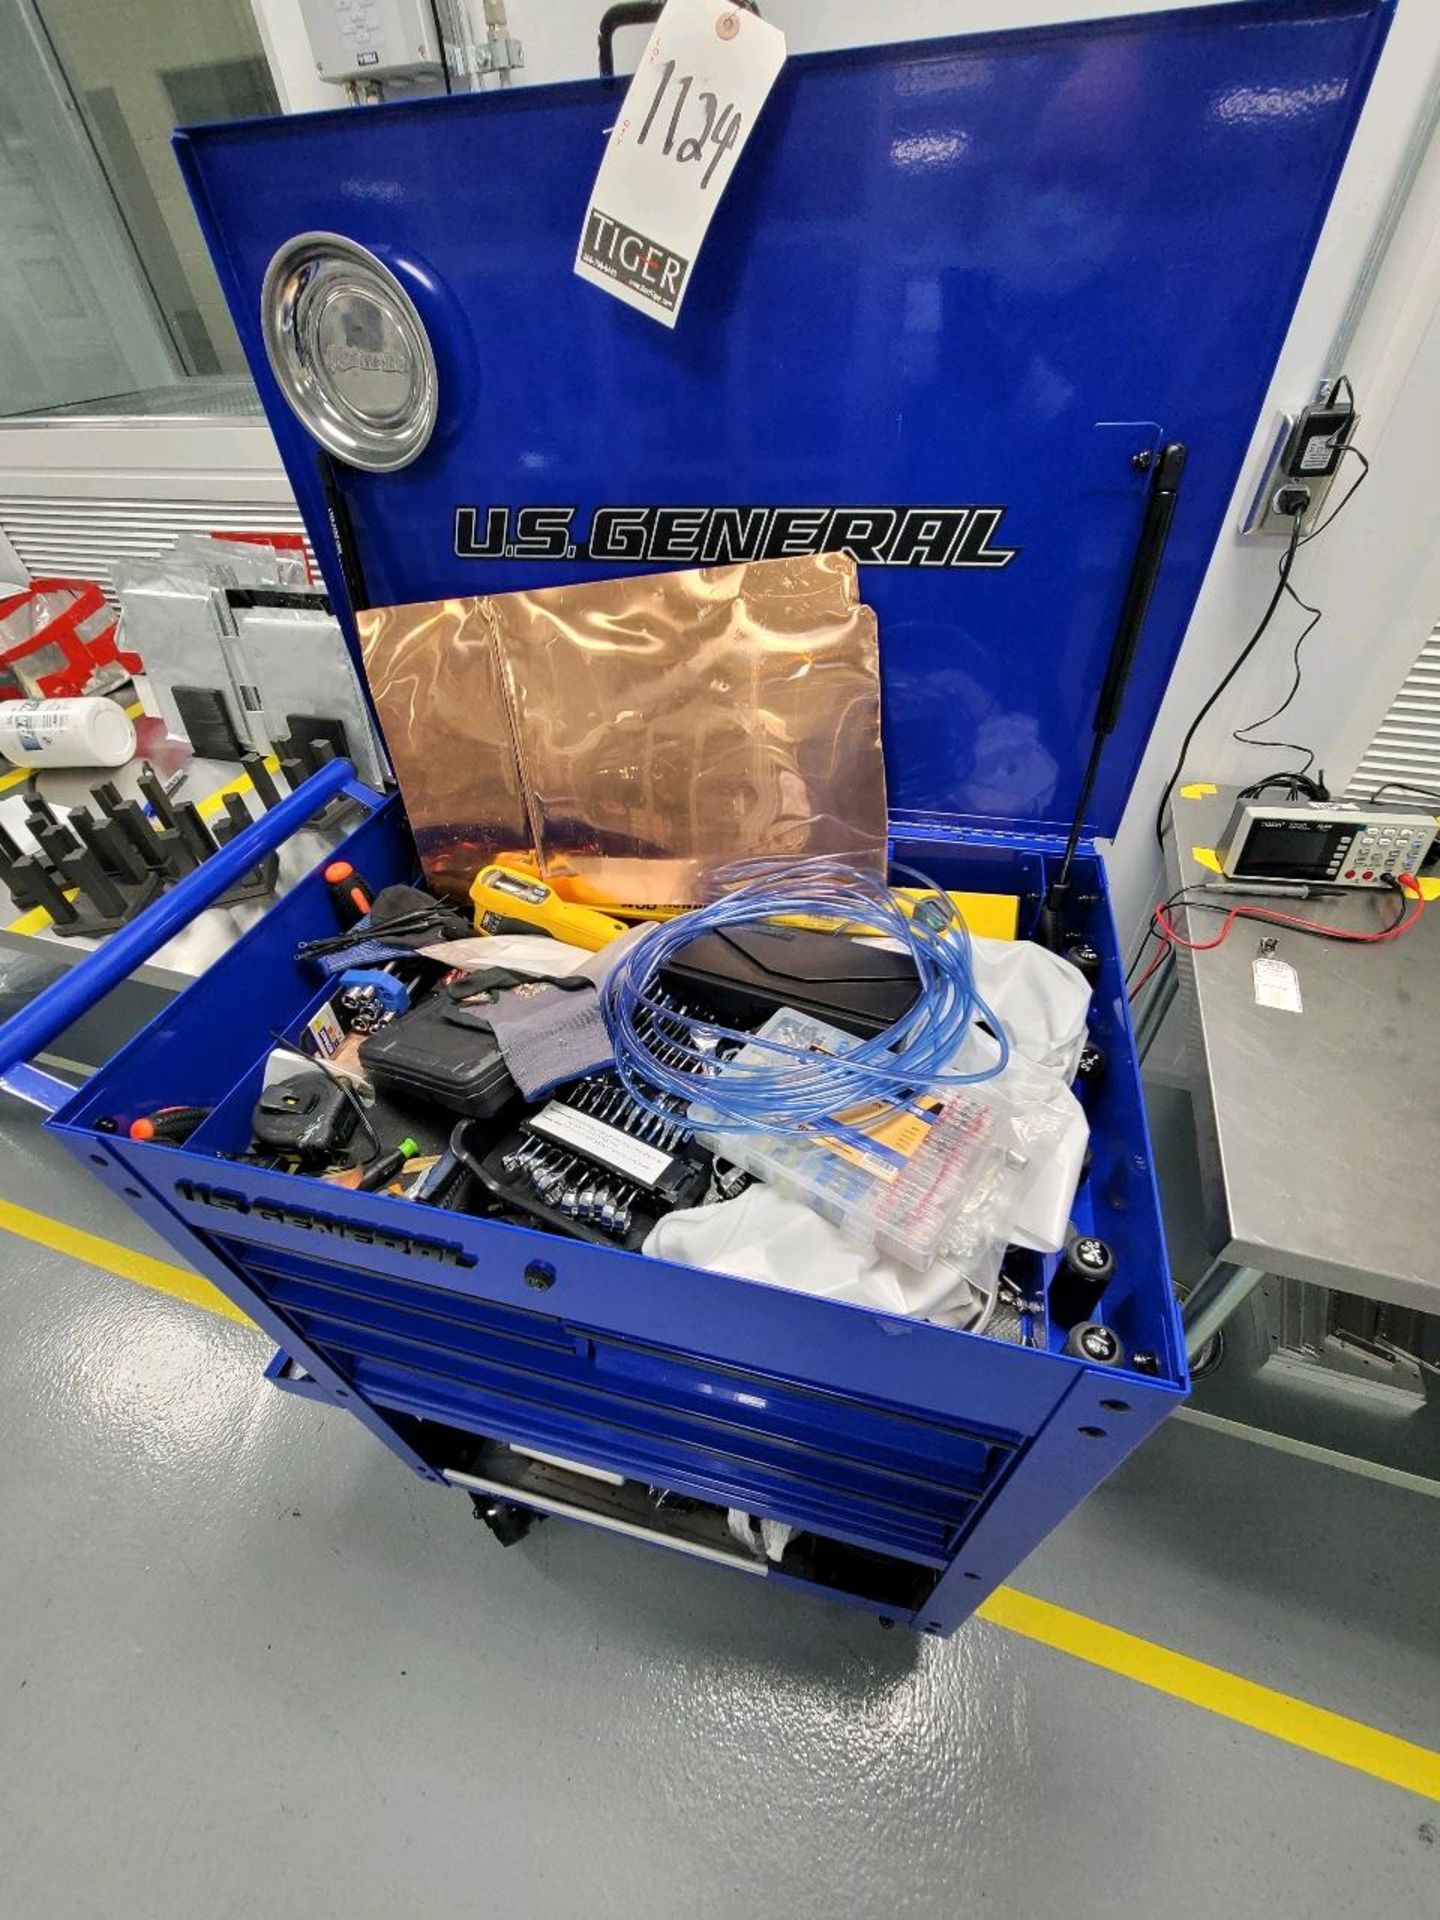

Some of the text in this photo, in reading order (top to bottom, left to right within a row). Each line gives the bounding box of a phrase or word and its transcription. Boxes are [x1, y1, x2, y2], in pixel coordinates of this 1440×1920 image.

[637, 59, 742, 190] 1124
[592, 210, 681, 295] TIGER
[453, 507, 1017, 567] U.S. GENERAL
